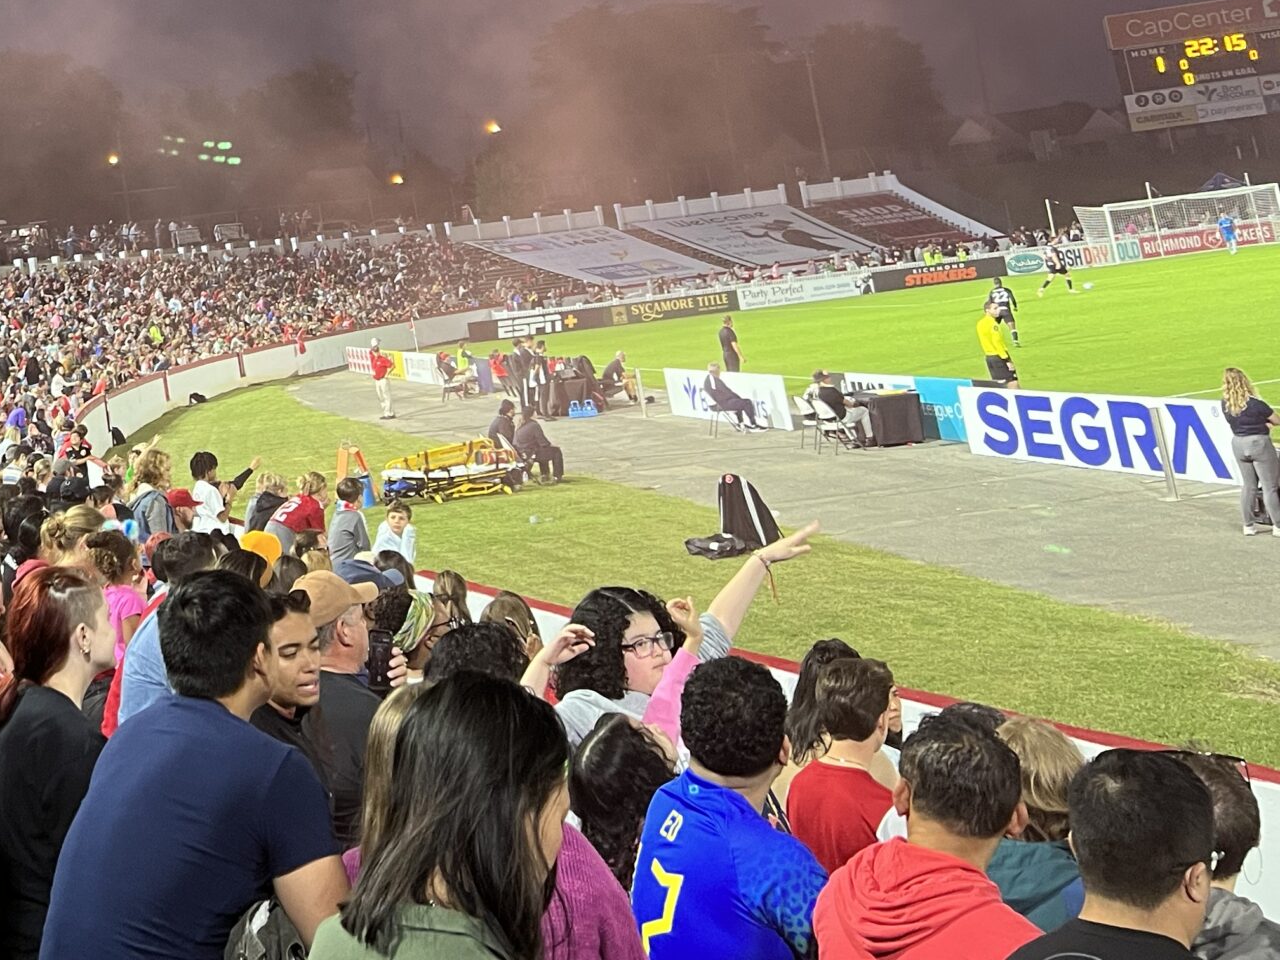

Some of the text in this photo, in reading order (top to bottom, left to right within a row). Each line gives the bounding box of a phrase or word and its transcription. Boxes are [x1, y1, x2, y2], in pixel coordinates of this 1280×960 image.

[1125, 6, 1253, 38] CapCenter
[1131, 47, 1167, 58] HOME
[1184, 33, 1248, 58] 22:15
[666, 211, 770, 228] Welcome
[837, 204, 903, 219] SHOP
[1143, 235, 1201, 254] RICHMOND
[1083, 244, 1109, 266] DRY
[905, 267, 977, 287] STRIKERS
[742, 288, 769, 301] Party
[772, 284, 804, 299] Perfect
[631, 297, 695, 322] SYCAMORE
[697, 293, 729, 307] TITLE
[976, 391, 1233, 479] SEGRA
